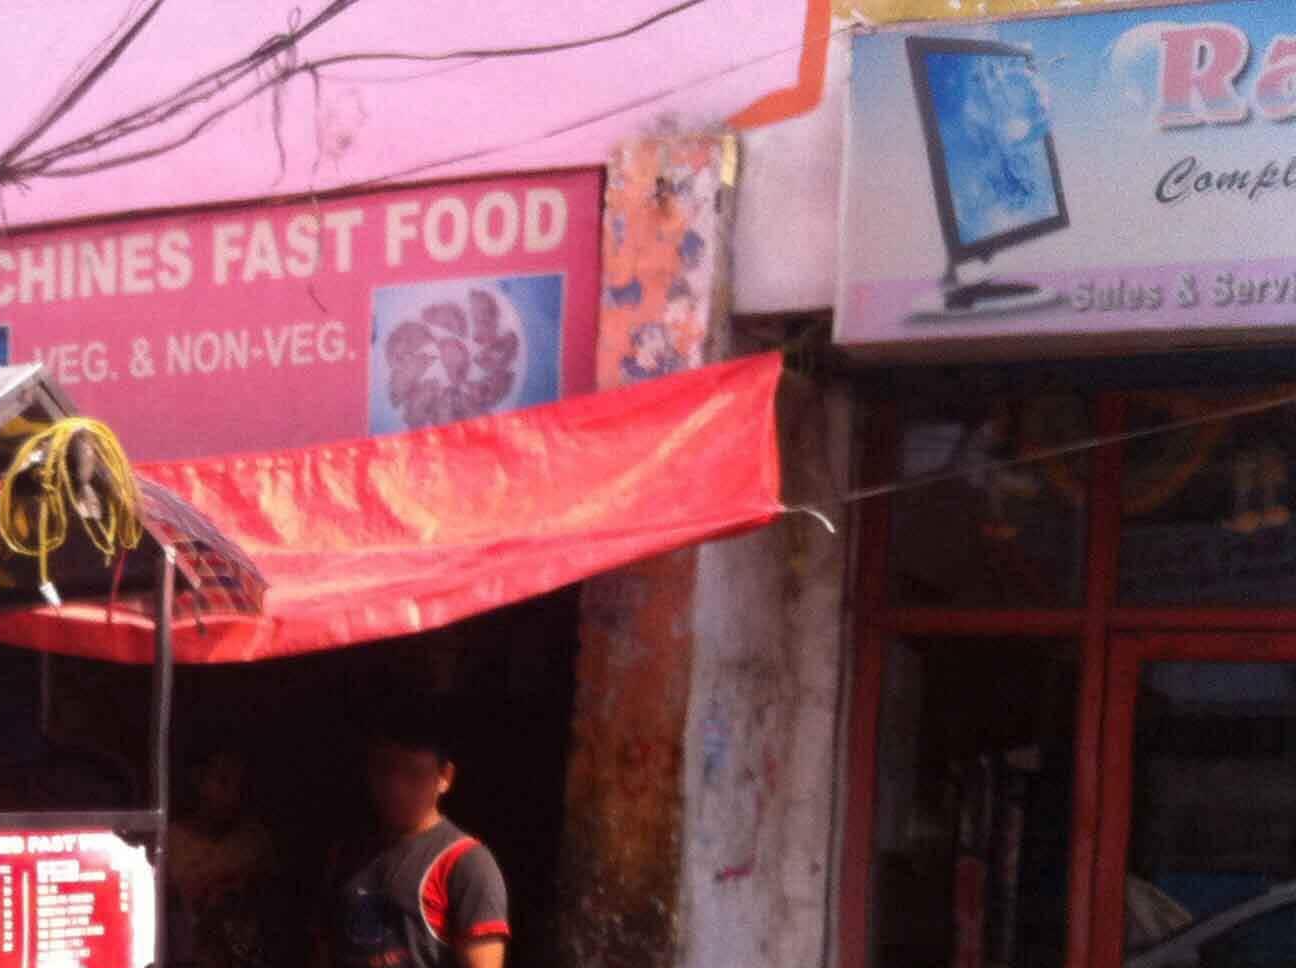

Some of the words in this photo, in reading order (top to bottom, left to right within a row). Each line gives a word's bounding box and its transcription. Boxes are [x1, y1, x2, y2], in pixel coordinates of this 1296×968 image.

[211, 208, 364, 285] FAST
[384, 187, 568, 268] FOOD
[128, 335, 156, 379] &
[166, 320, 356, 377] NON-VEG.
